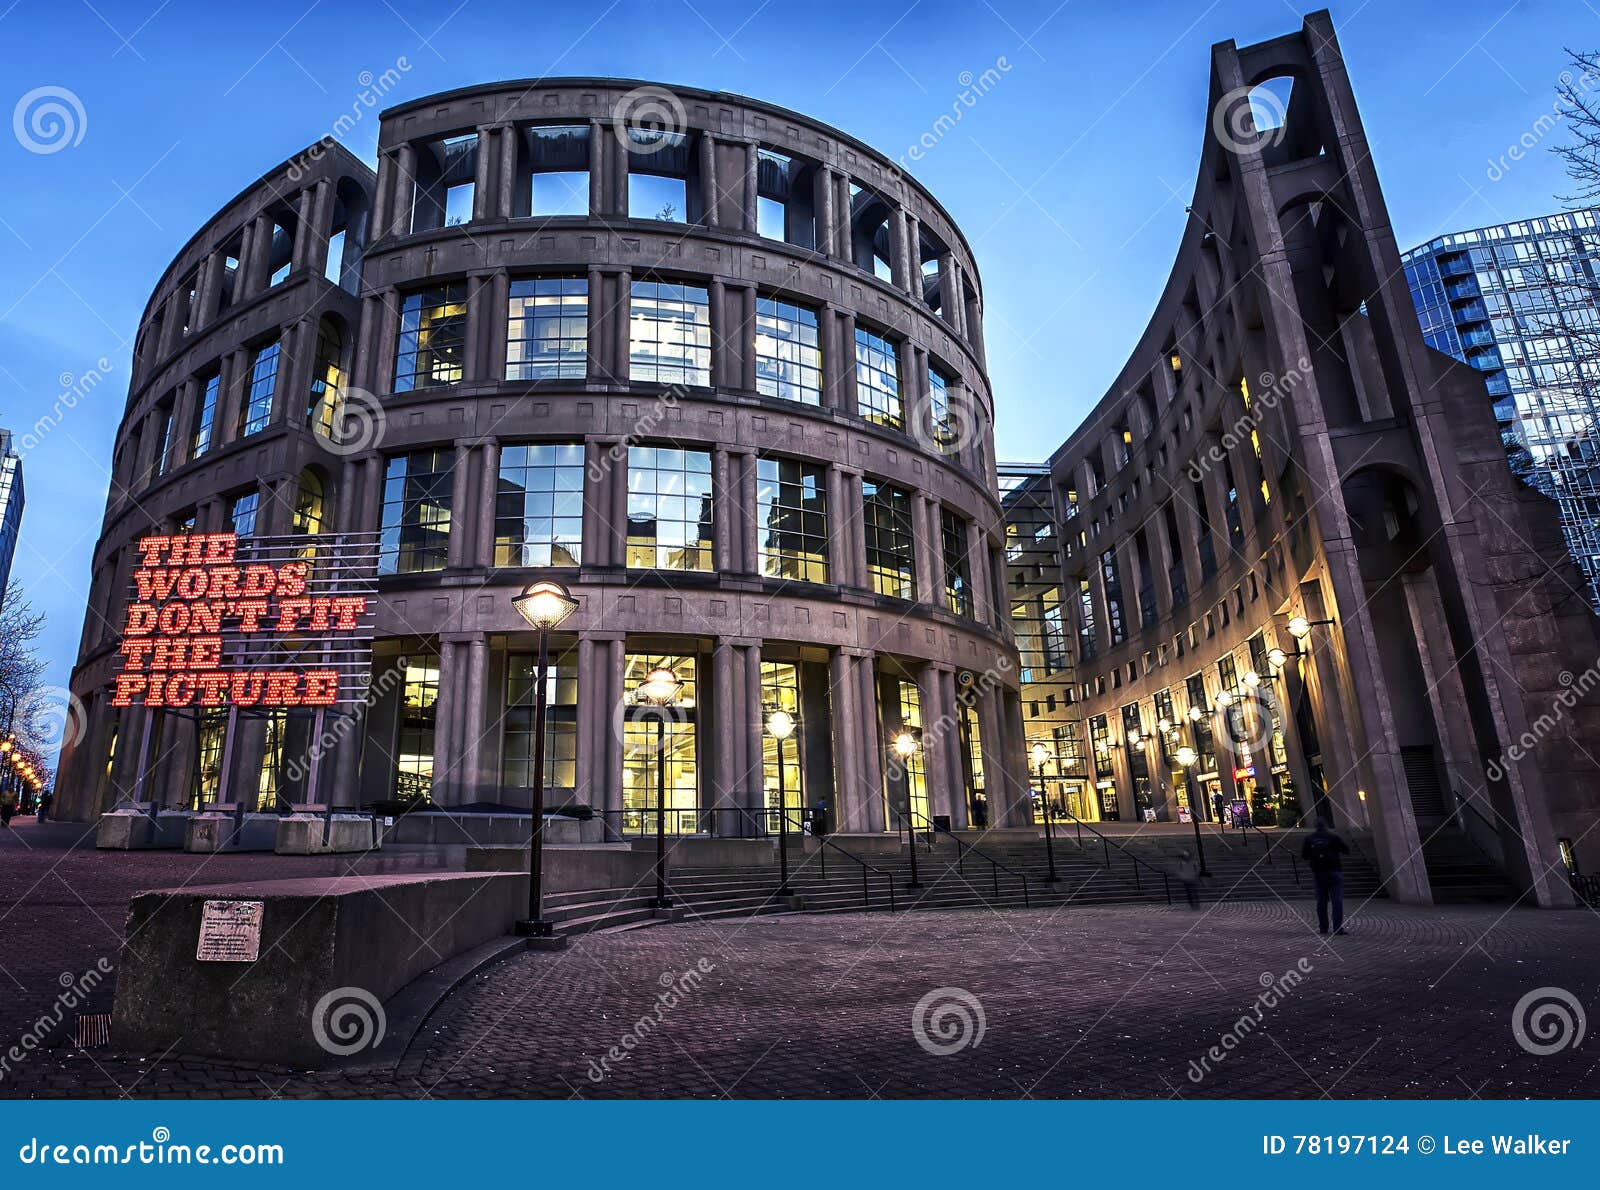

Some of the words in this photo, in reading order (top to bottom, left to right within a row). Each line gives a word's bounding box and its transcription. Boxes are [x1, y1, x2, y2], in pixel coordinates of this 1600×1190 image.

[139, 533, 237, 566] THE
[134, 562, 308, 600] WORDS
[124, 600, 268, 635] DON'T
[276, 597, 366, 631] FIT
[121, 636, 222, 670] THE
[112, 670, 339, 707] PICTURE
